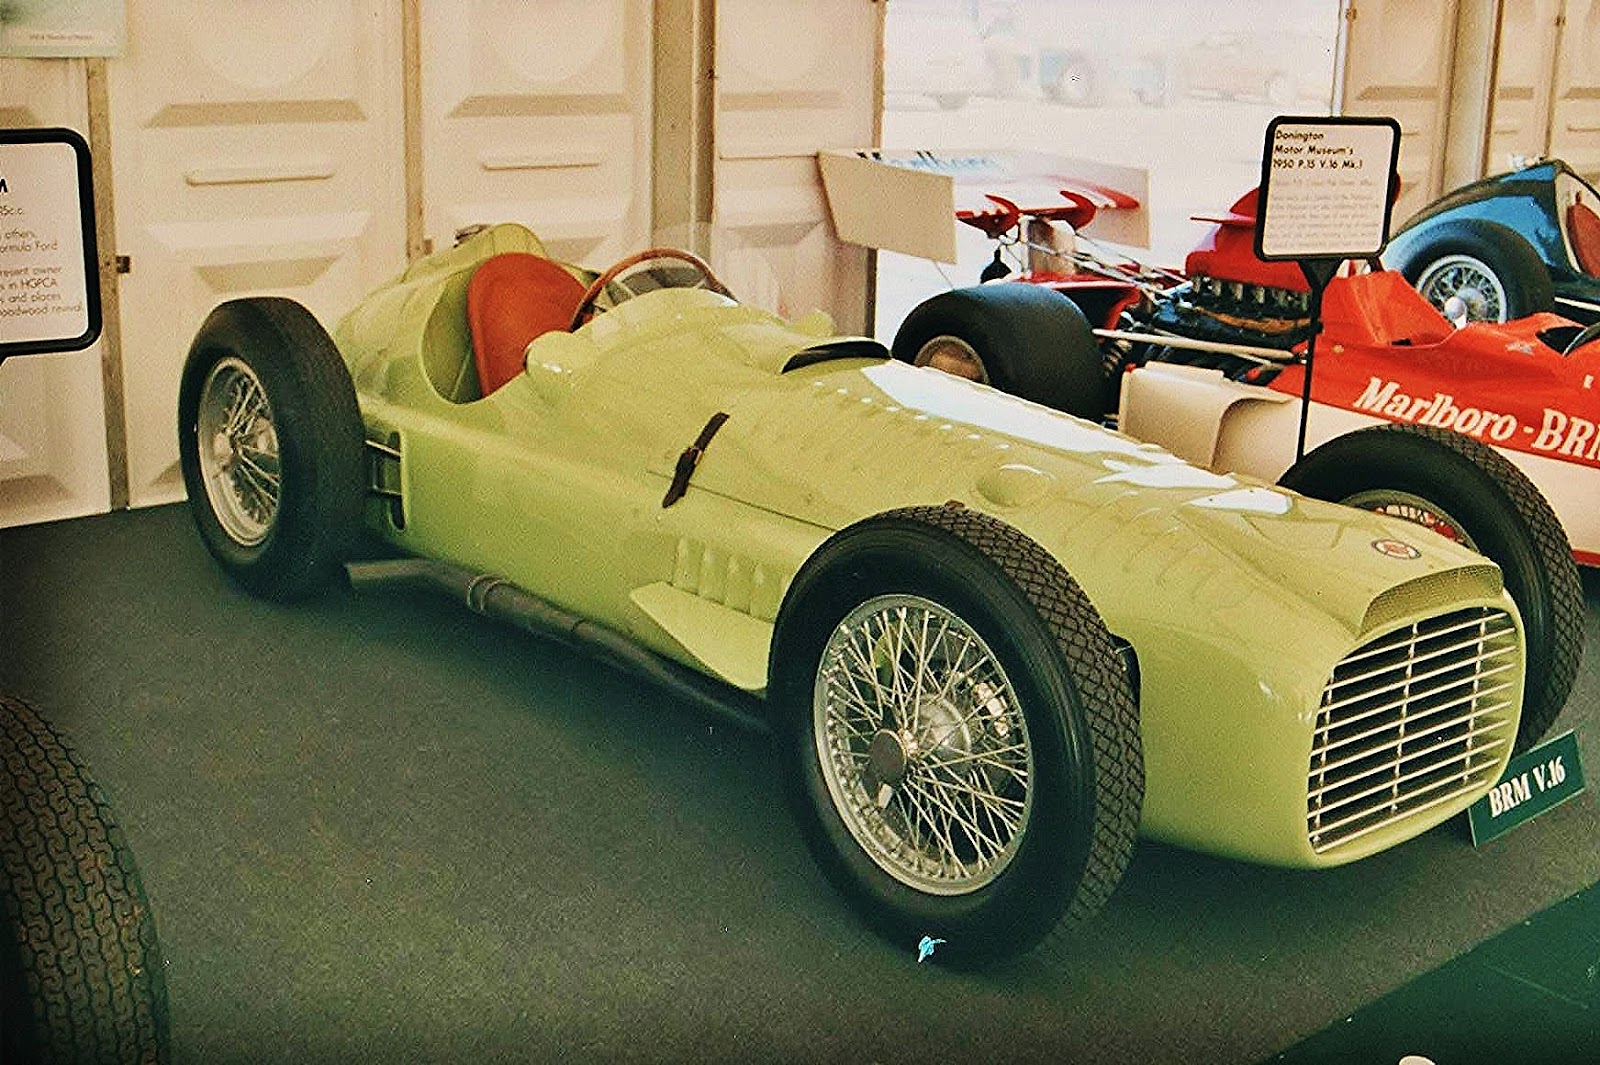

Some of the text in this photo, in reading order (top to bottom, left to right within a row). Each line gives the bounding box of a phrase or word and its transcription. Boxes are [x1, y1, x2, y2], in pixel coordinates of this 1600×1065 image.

[1274, 145, 1354, 155] Motor Museum's
[1275, 130, 1324, 142] Donington
[1353, 376, 1517, 442] Marlboro
[1488, 755, 1566, 818] BRM V.16
